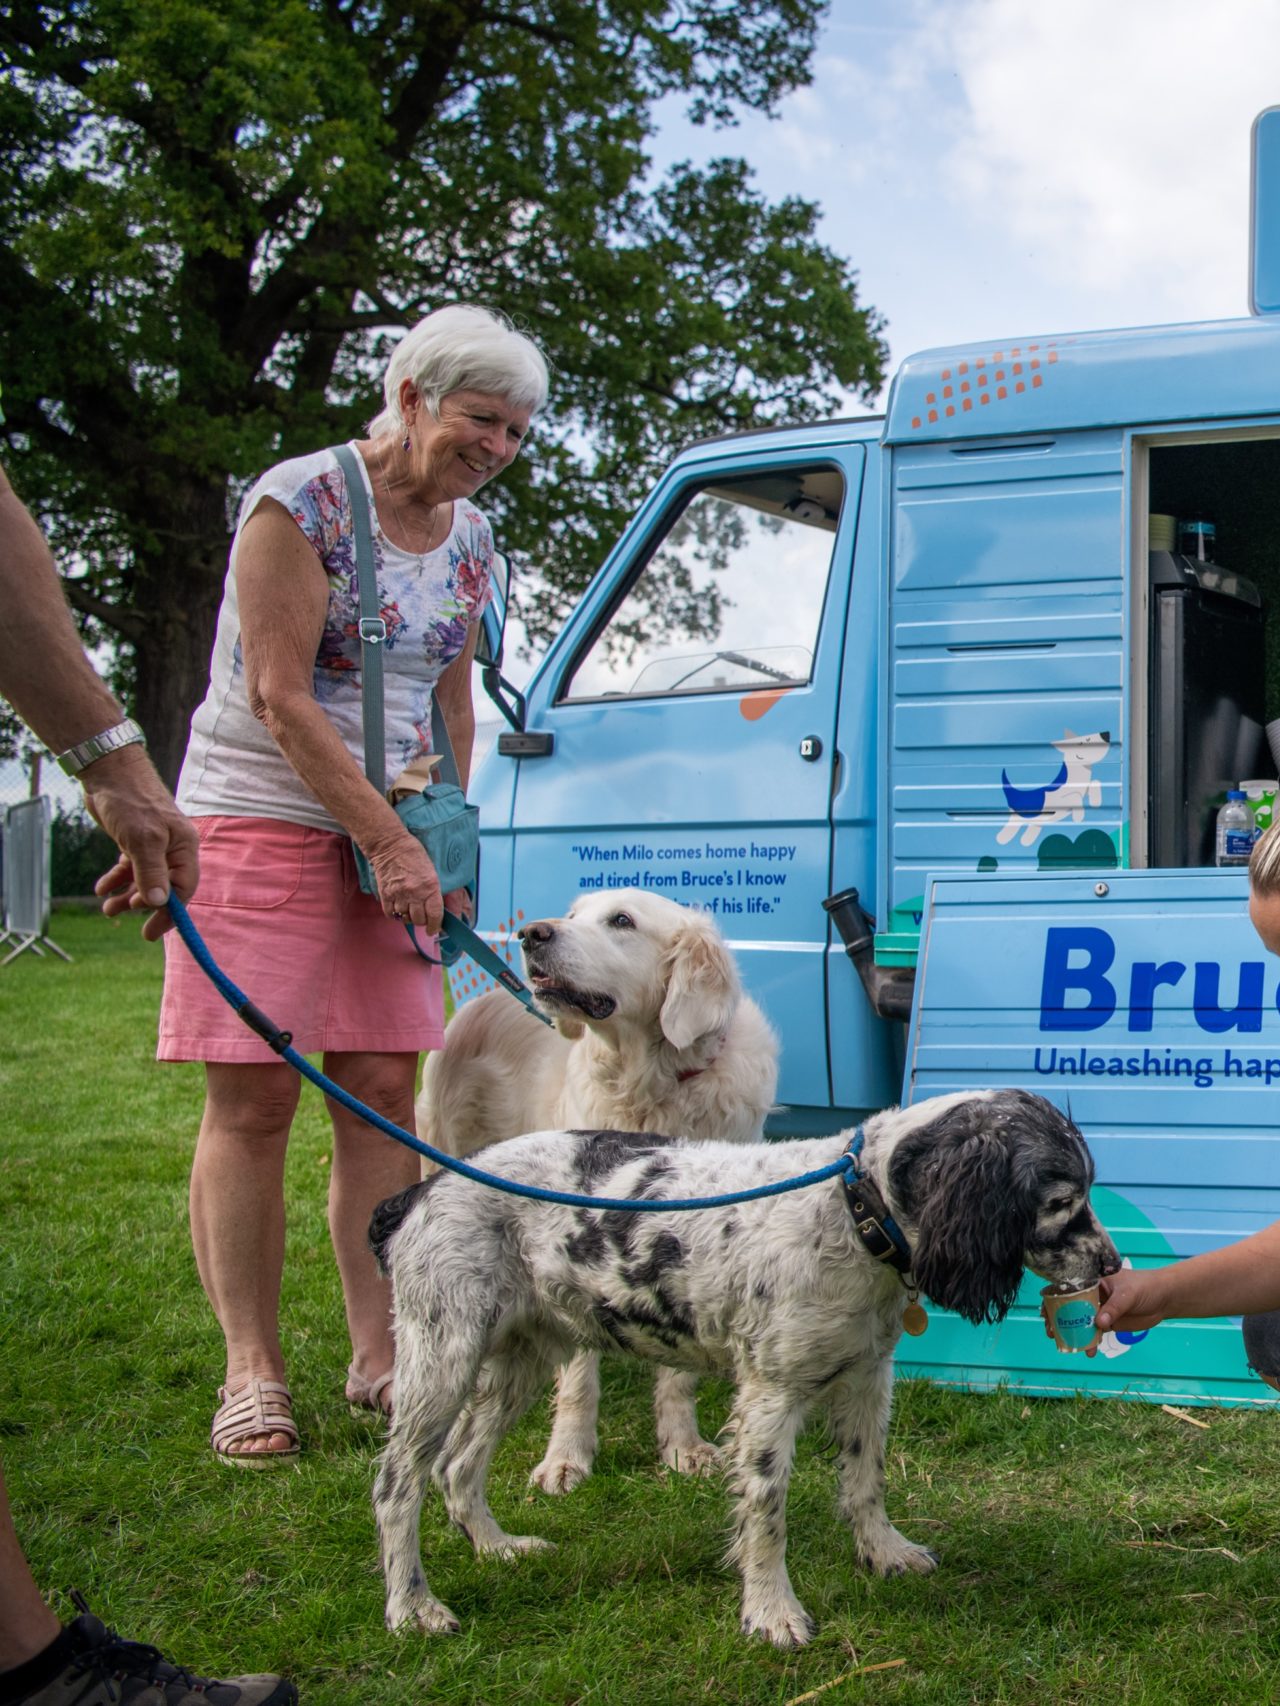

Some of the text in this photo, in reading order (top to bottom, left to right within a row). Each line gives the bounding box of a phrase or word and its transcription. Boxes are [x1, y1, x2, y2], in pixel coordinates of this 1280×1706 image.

[571, 842, 796, 861] "When Milo comes home happy
[579, 870, 787, 888] and tired from Bruce's I know
[703, 897, 719, 913] of
[722, 897, 743, 913] his
[747, 897, 781, 914] life."
[1034, 1047, 1214, 1088] Unleashing
[1057, 1314, 1092, 1325] Bruce's
